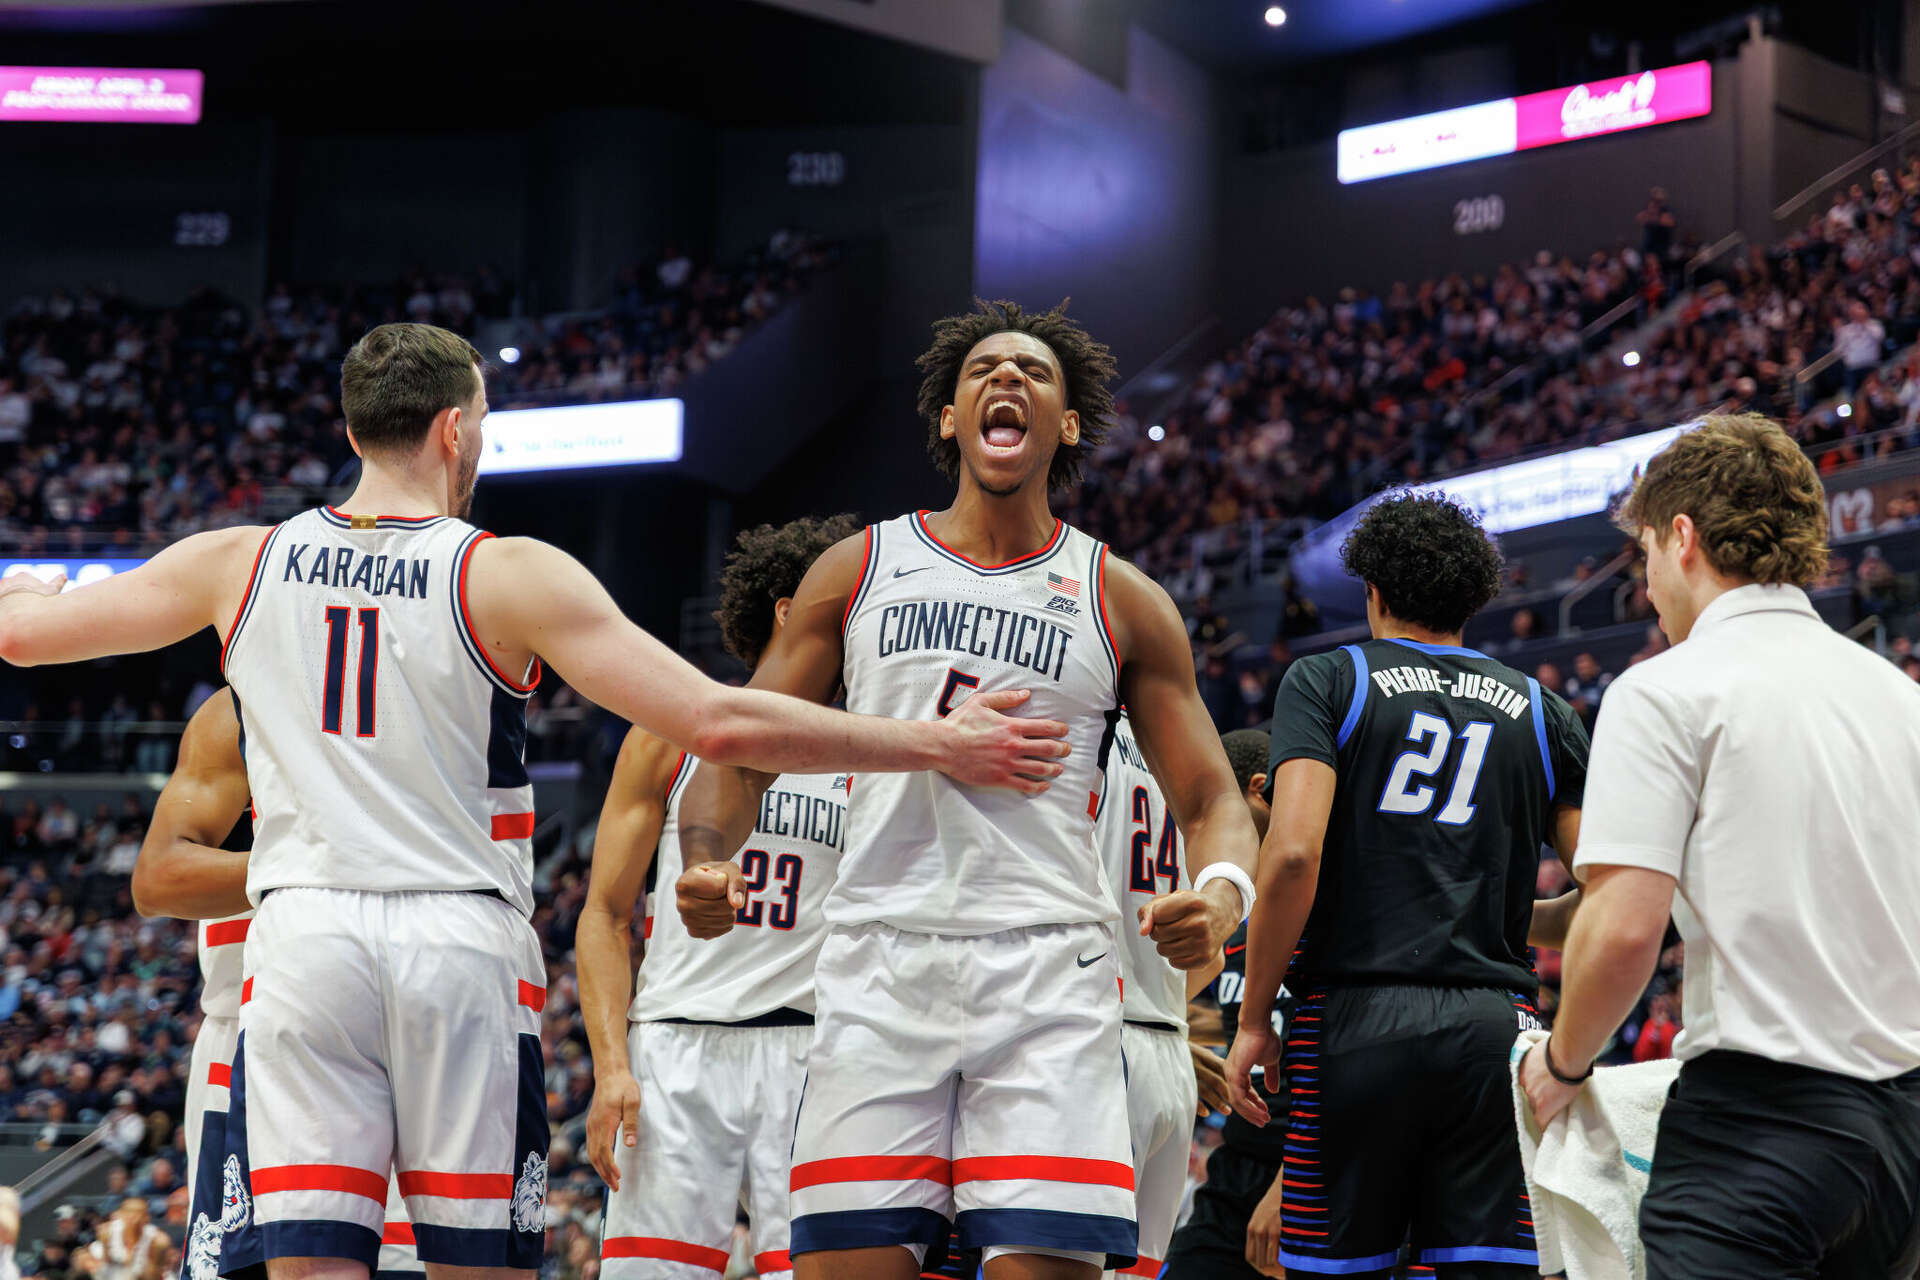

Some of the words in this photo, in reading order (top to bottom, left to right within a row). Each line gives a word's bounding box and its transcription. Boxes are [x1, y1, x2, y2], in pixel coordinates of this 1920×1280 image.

[283, 544, 430, 599] KARABAN
[1046, 601, 1081, 615] EAST
[1051, 595, 1077, 607] BIG
[322, 605, 379, 737] 11
[879, 601, 1073, 682] CONNECTICUT
[1371, 666, 1530, 720] PIERRE-JUSTIN
[1376, 709, 1496, 826] 21
[1129, 785, 1180, 895] 24
[735, 848, 804, 931] 23
